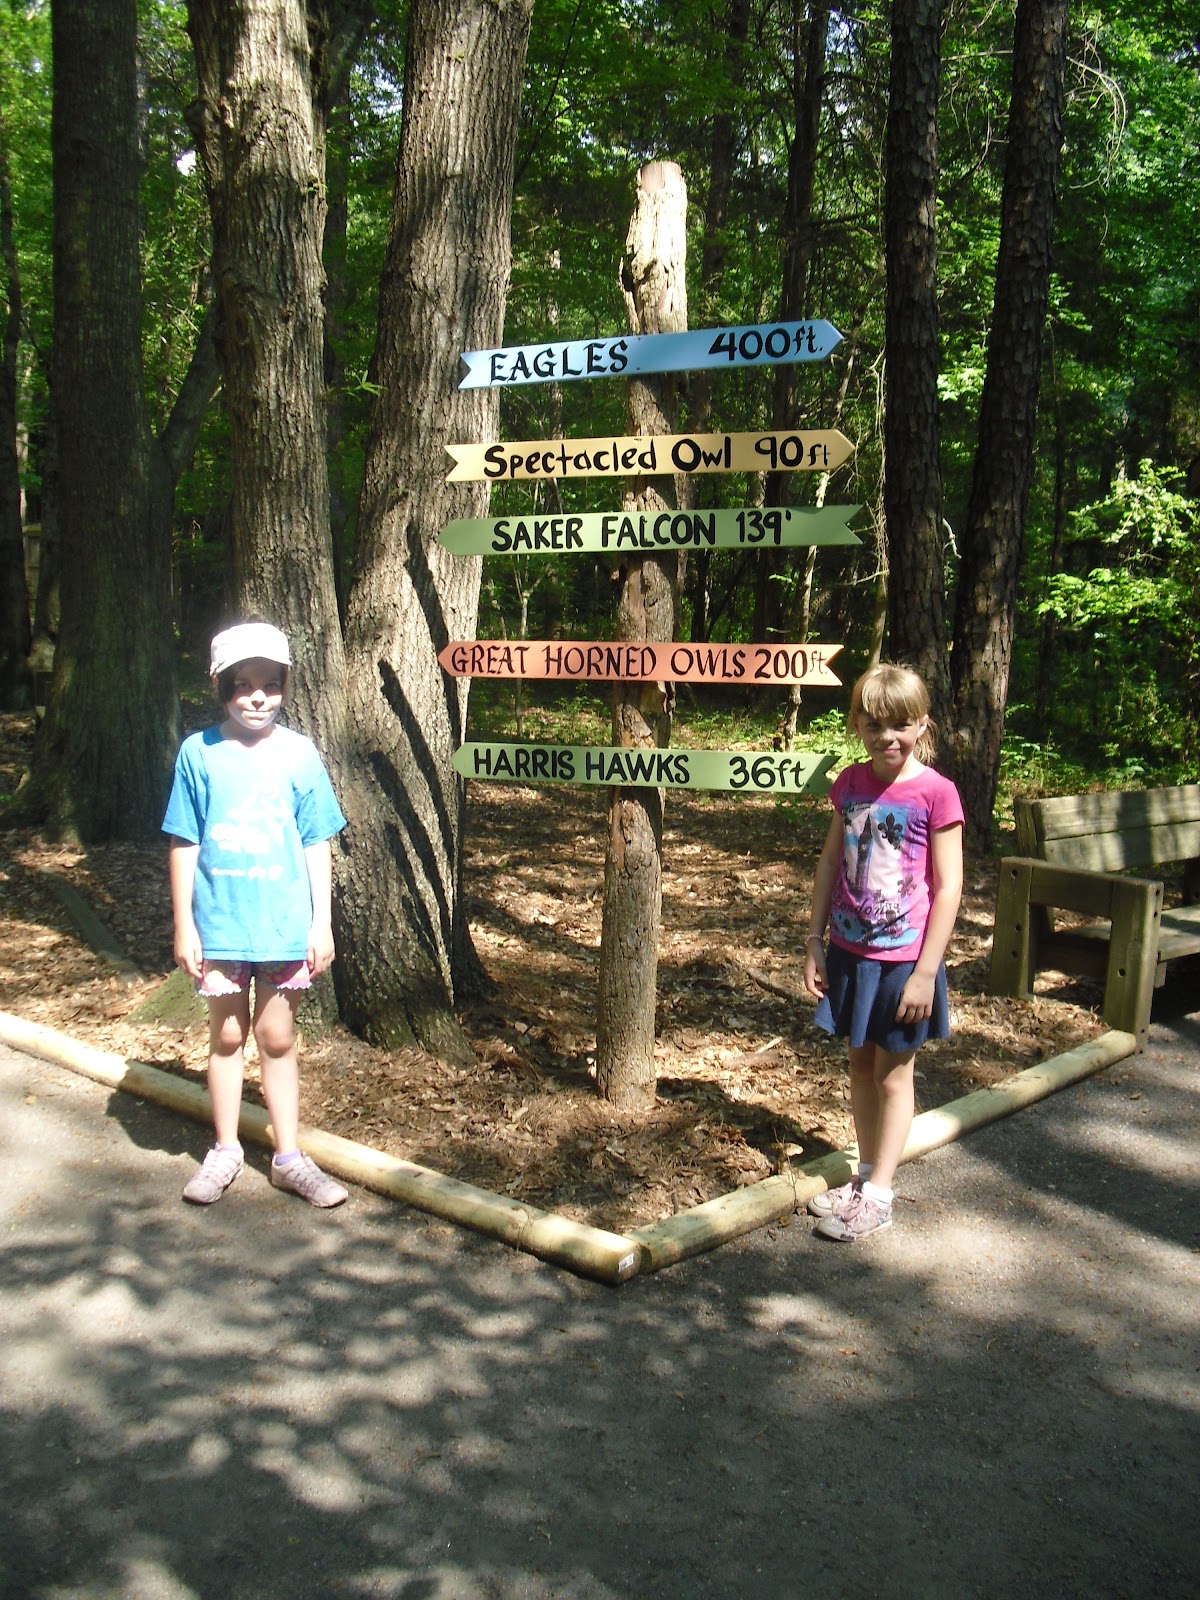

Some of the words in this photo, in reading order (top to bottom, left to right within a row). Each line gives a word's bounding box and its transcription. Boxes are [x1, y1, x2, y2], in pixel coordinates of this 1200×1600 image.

[489, 339, 629, 384] EAGLES
[484, 437, 657, 479] Spectacled
[670, 436, 732, 472] Owl
[491, 516, 584, 552] SAKER
[600, 512, 717, 549] FALCON
[736, 509, 792, 545] 139'
[450, 645, 529, 676] GREAT
[543, 645, 657, 678] HORNED
[670, 648, 746, 678] OWLS
[473, 748, 576, 780] HARRIS
[584, 751, 690, 785] HAWKS
